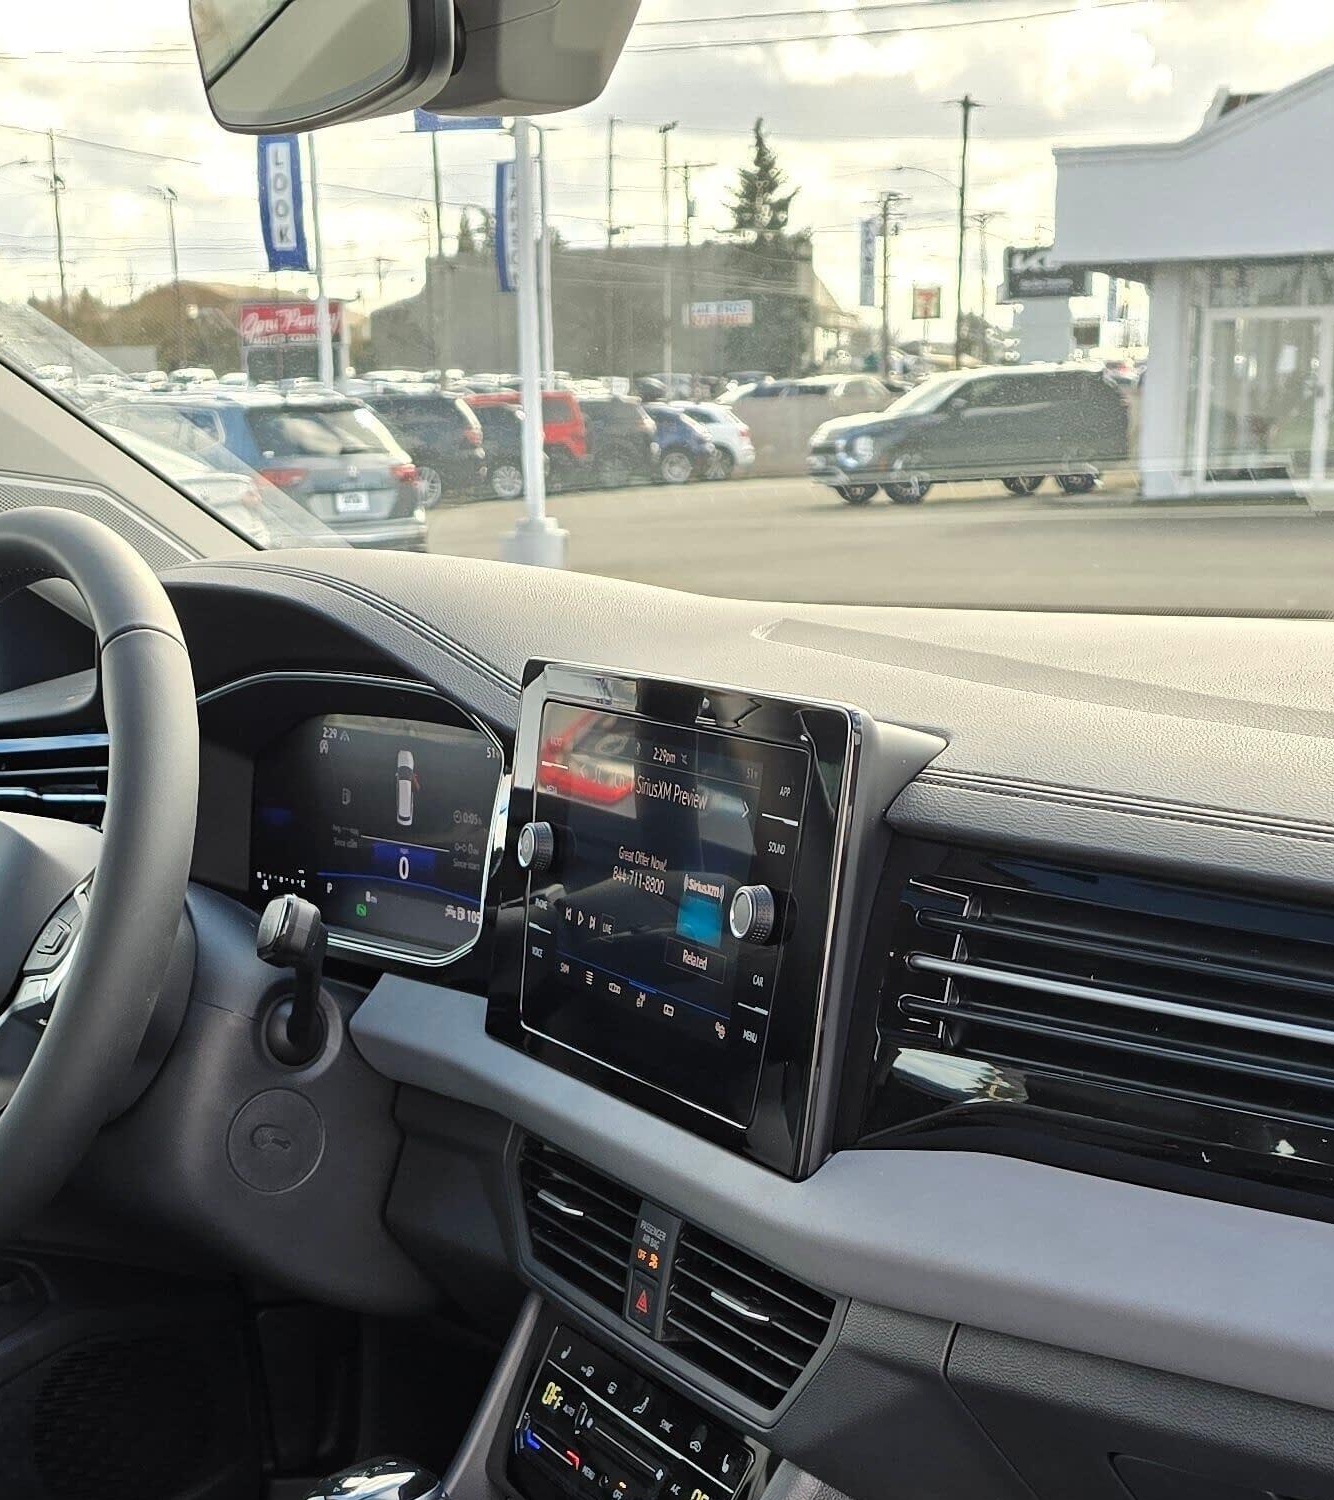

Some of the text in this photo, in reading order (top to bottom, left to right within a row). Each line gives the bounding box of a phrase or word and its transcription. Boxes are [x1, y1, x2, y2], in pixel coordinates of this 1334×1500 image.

[273, 151, 290, 243] LOOK
[653, 747, 676, 764] 2:29pm
[636, 775, 672, 802] SiriusXM
[673, 784, 708, 810] Preview
[779, 785, 791, 797] APP
[619, 845, 635, 862] Great
[635, 850, 650, 866] Offer
[768, 841, 785, 854] SOUND
[399, 856, 409, 880] 0
[467, 908, 481, 924] 105
[683, 949, 708, 971] Related
[752, 974, 764, 988] CAR
[743, 1028, 758, 1044] MENU
[640, 1219, 667, 1242] PASSENGER
[650, 1237, 660, 1251] BAG
